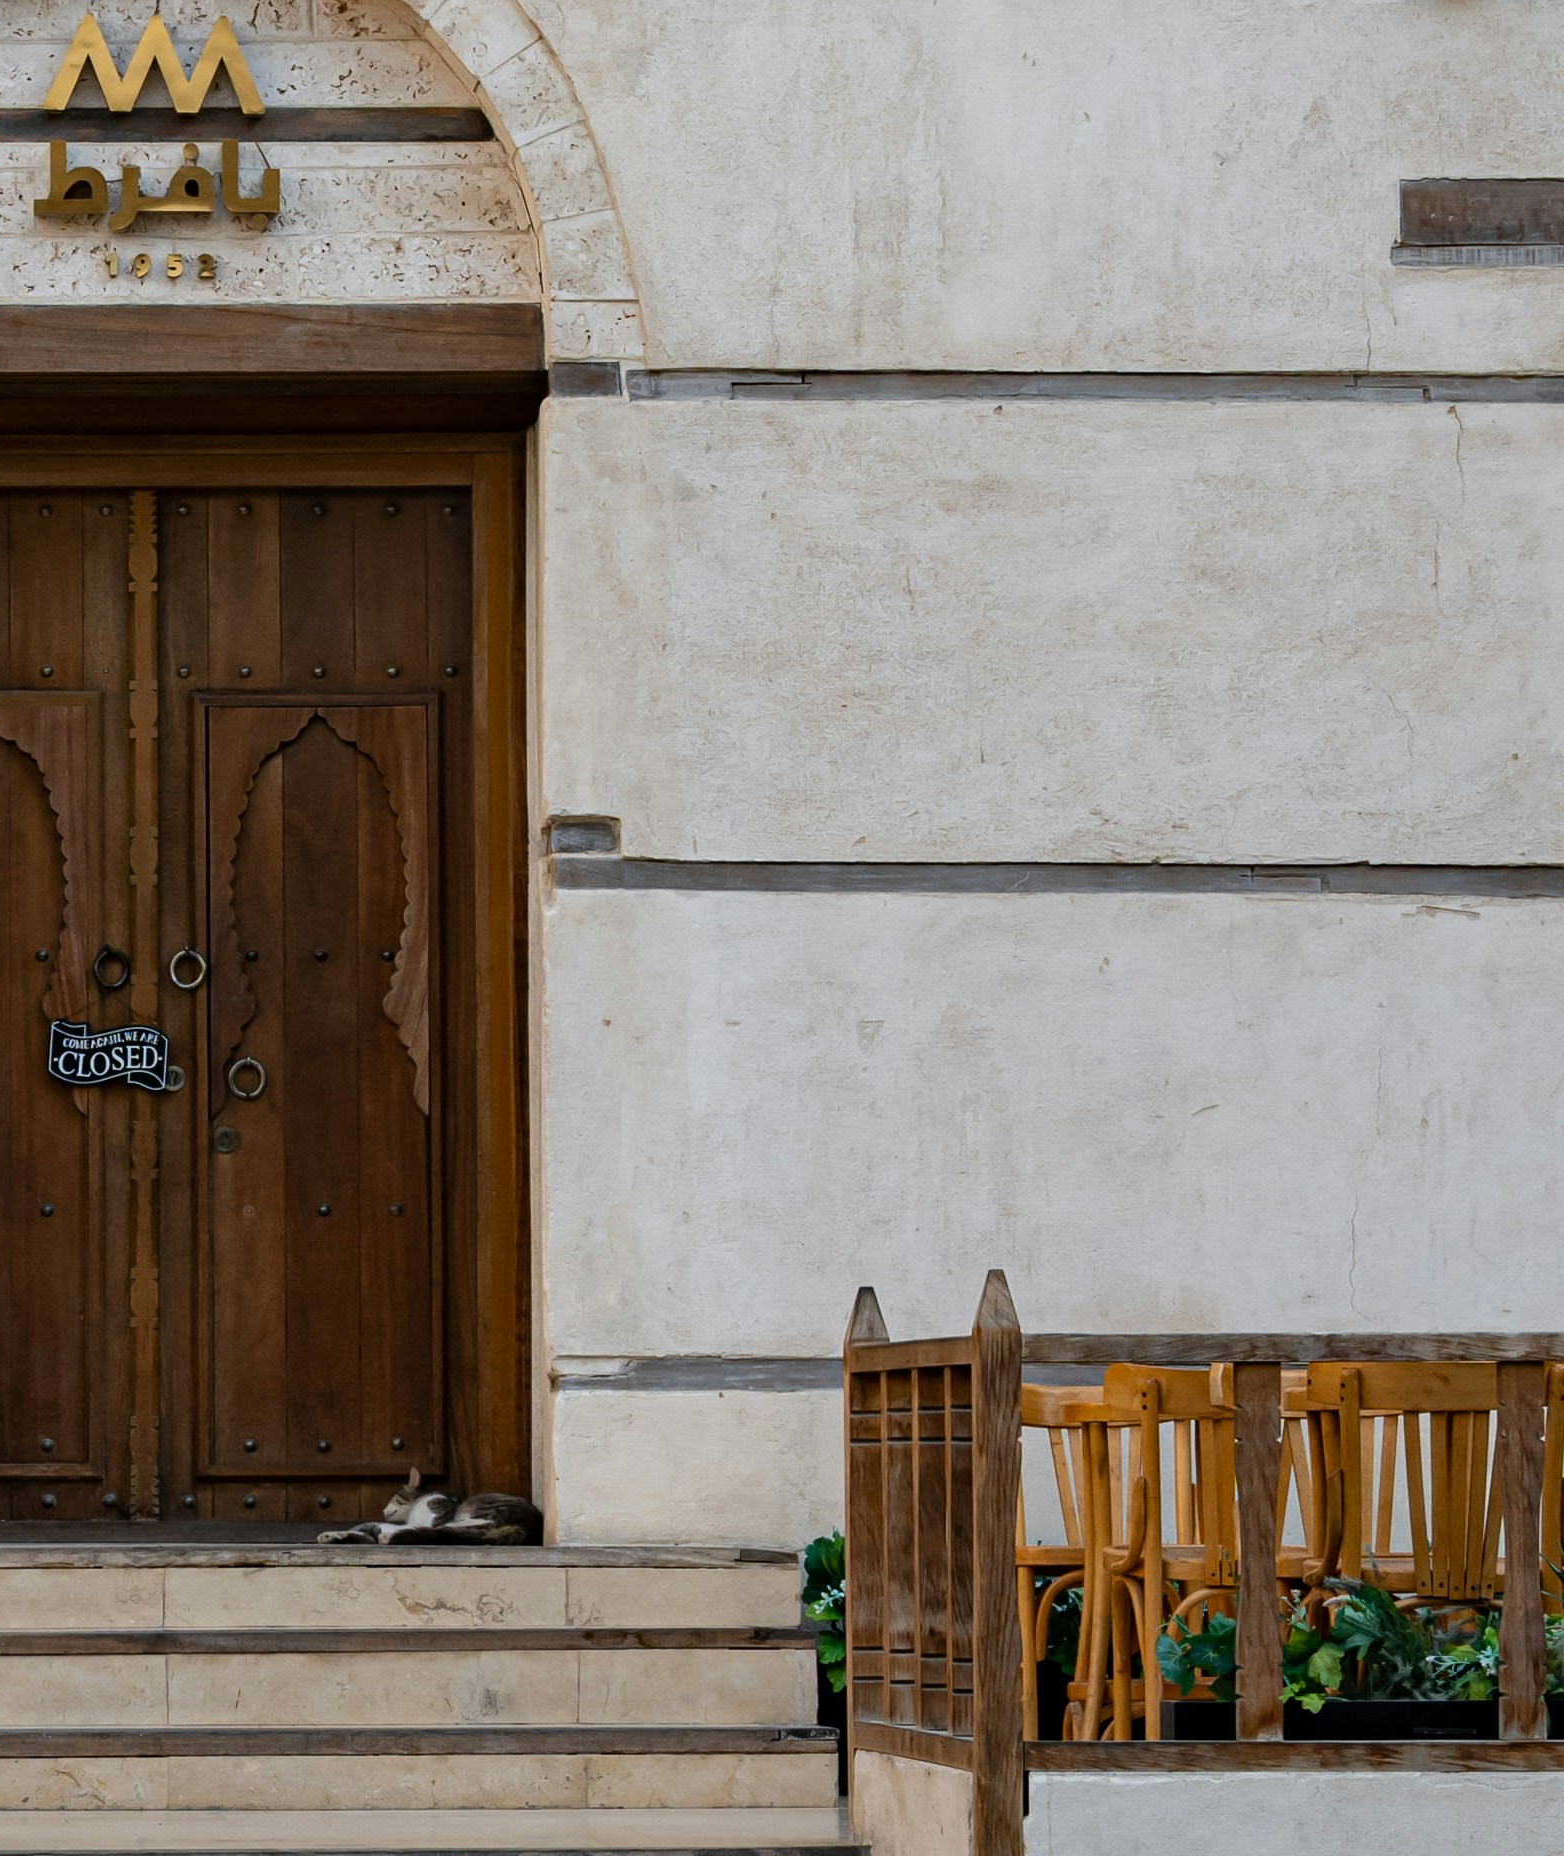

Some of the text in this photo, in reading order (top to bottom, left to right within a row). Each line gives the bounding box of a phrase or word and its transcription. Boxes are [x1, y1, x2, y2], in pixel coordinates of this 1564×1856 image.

[105, 252, 218, 279] 1952
[63, 1037, 89, 1049] COME
[125, 1031, 138, 1042] WE
[140, 1032, 158, 1045] ARE
[58, 1045, 158, 1077] CLOSED
